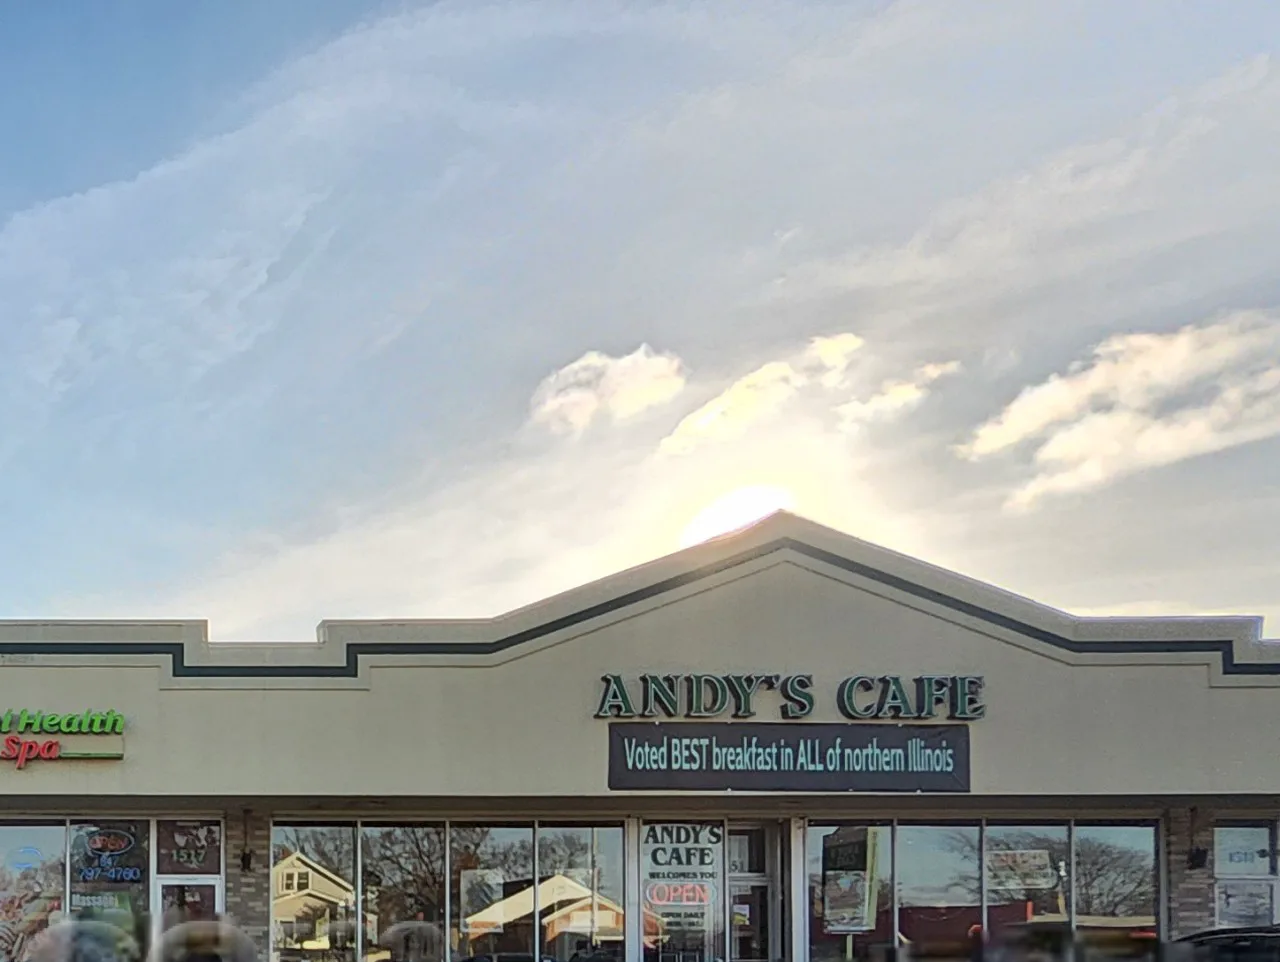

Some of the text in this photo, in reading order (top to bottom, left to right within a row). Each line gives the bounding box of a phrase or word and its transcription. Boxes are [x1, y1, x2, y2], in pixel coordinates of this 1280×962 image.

[594, 674, 986, 720] ANDY'S CAFE
[19, 708, 124, 734] Health
[0, 736, 61, 770] Spa
[624, 736, 954, 773] Voted BEST breakfast in ALL of northern Illinois
[643, 825, 723, 845] ANDY'S
[651, 847, 715, 866] CAFE
[652, 882, 710, 905] OPEN
